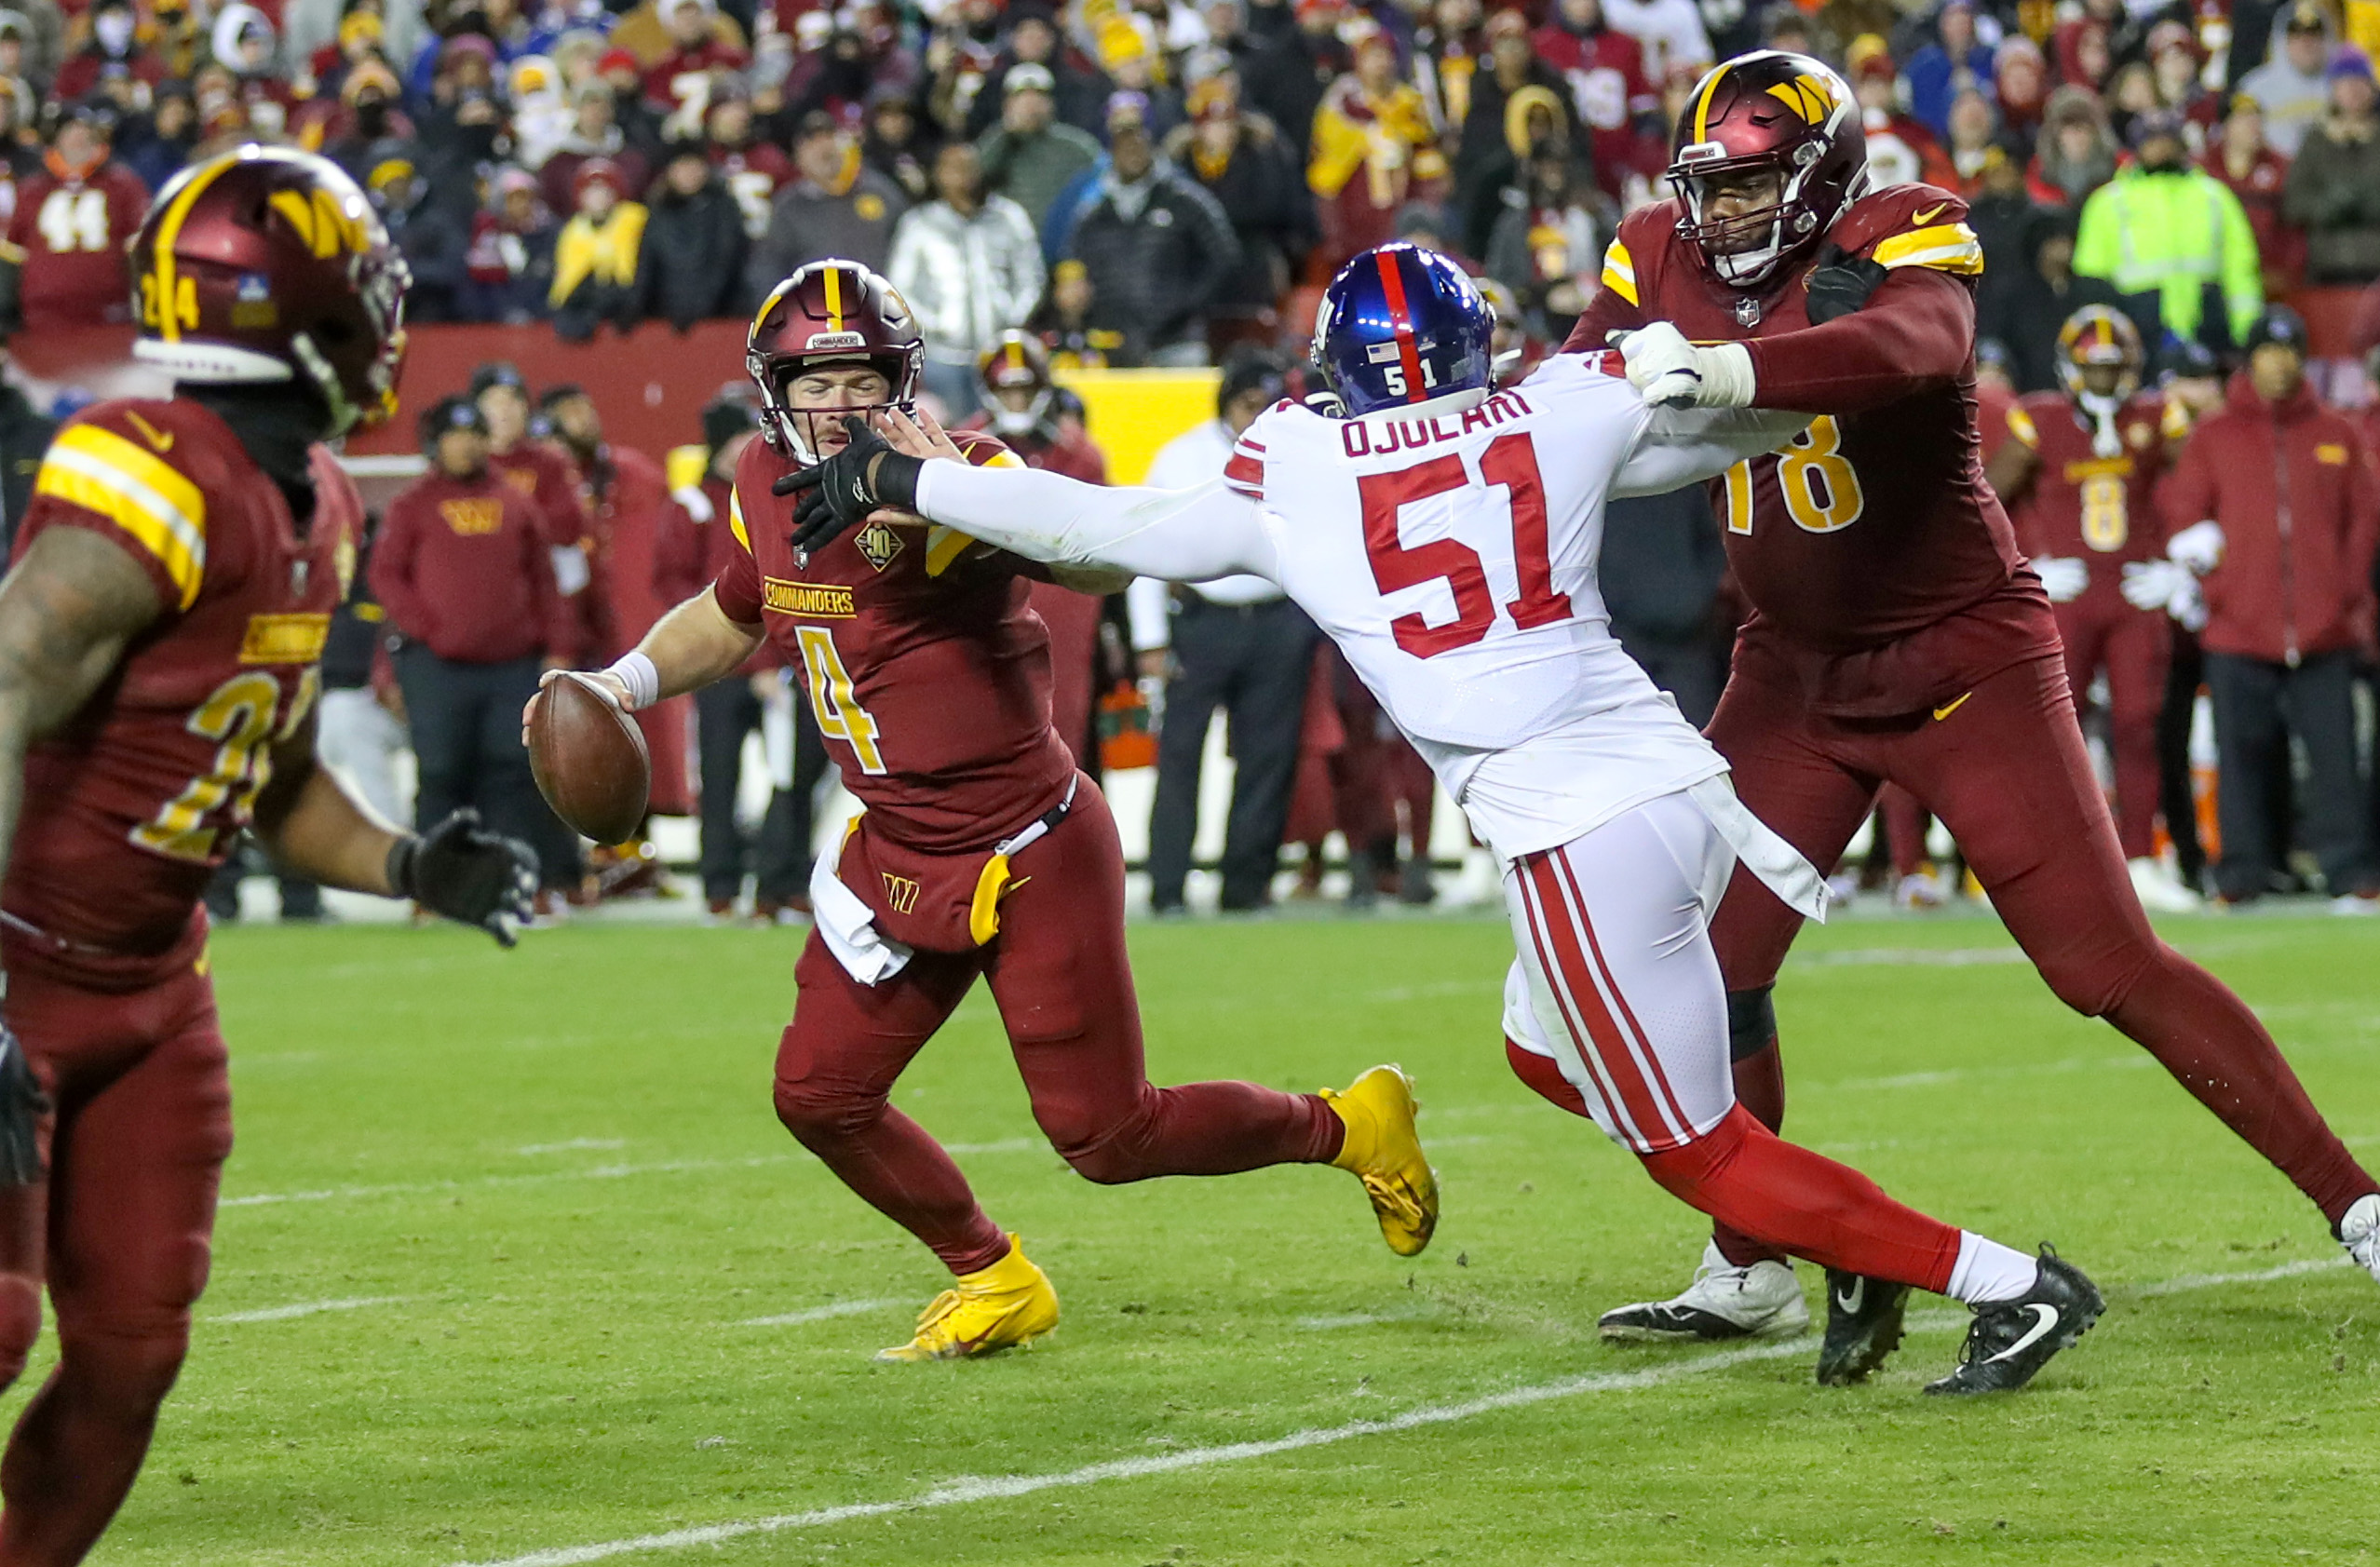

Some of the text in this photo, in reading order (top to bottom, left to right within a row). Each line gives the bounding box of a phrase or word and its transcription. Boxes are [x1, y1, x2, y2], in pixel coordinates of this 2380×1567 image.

[38, 189, 110, 253] 44
[1383, 358, 1438, 397] 51
[1342, 390, 1534, 458] OJULARI
[866, 528, 891, 559] 90
[1356, 431, 1574, 659] 51
[764, 582, 855, 613] COMMANDERS
[794, 625, 888, 775] 4
